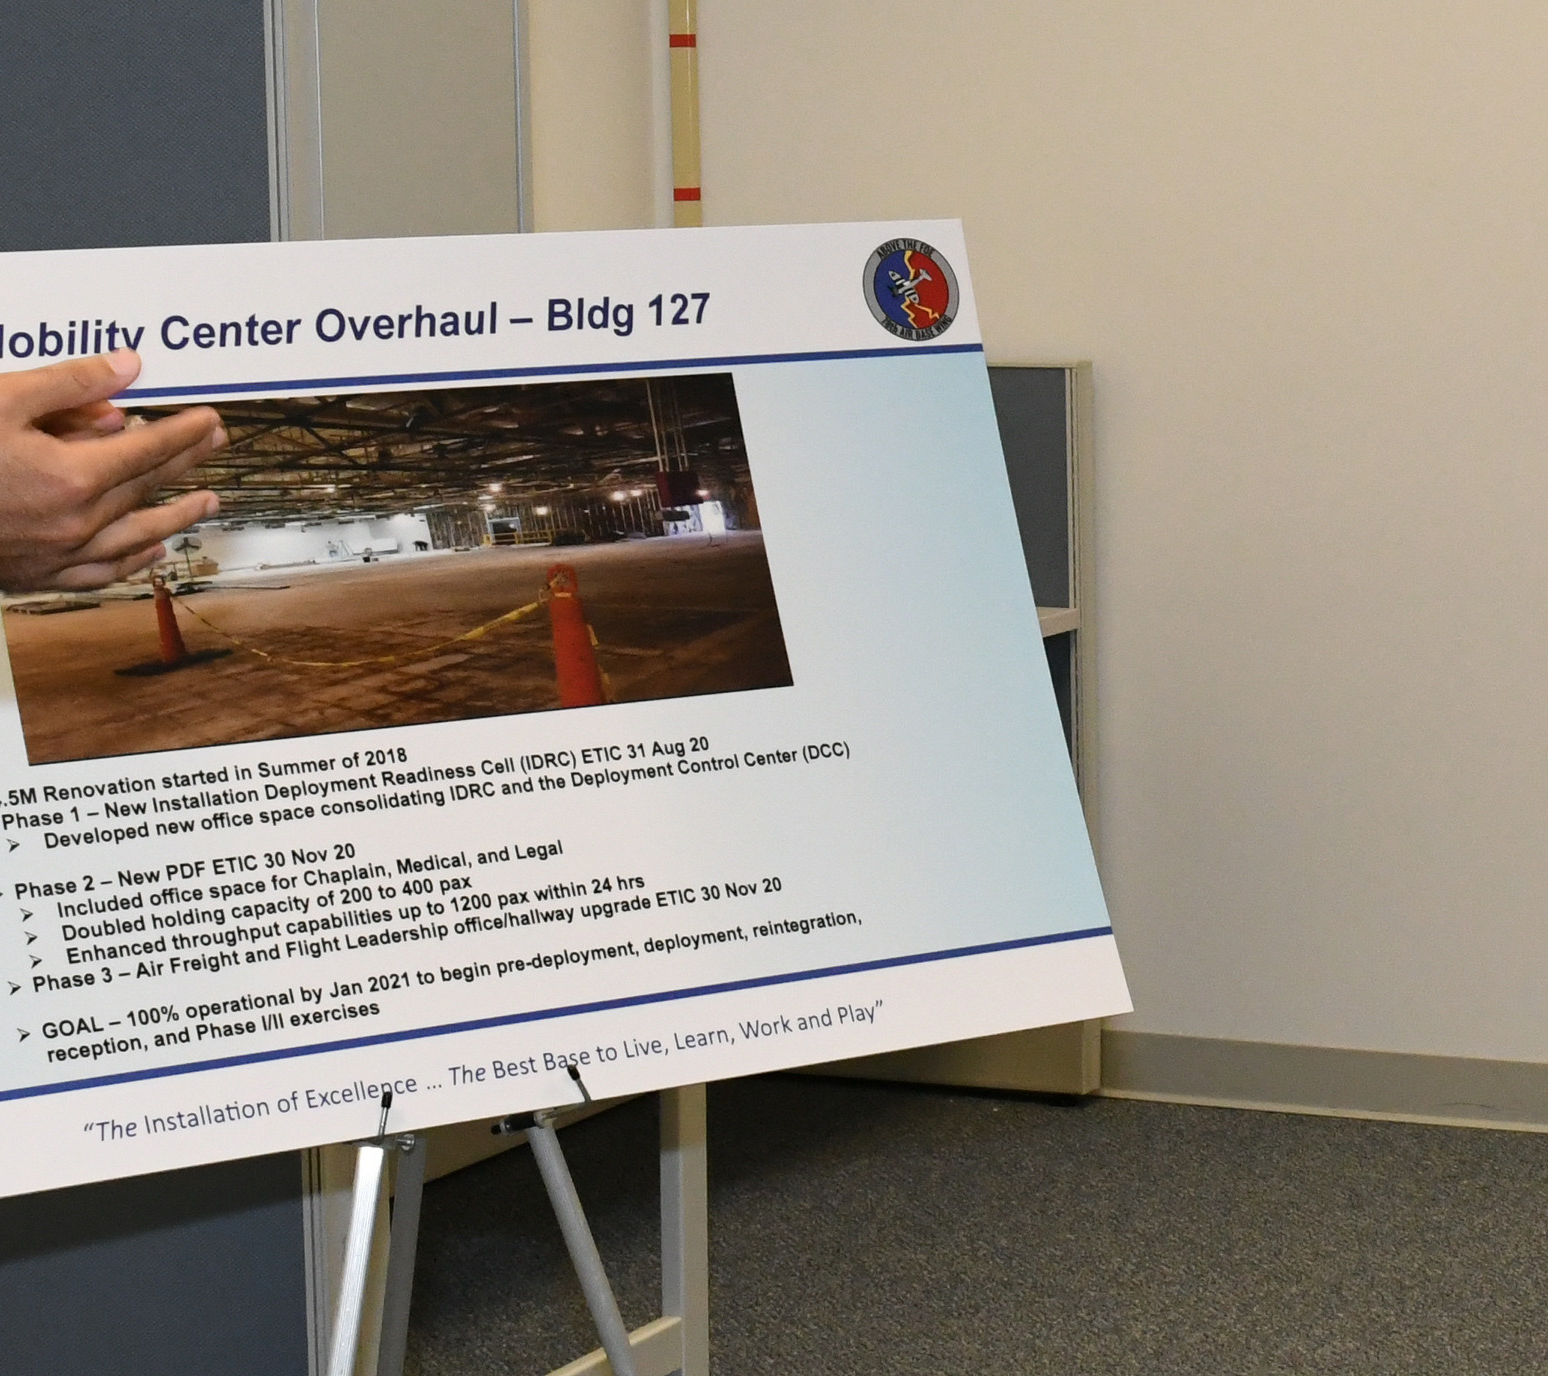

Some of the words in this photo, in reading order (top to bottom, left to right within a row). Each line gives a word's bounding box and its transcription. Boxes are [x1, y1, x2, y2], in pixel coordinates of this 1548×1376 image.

[876, 239, 902, 260] ABOVE
[902, 239, 918, 251] THE
[919, 241, 935, 258] FOE
[160, 313, 302, 351] Center
[315, 301, 498, 343] Overhaul
[547, 296, 634, 337] Bldg
[648, 292, 711, 327] 127
[900, 328, 914, 340] AIR
[915, 327, 935, 340] BASE
[935, 314, 953, 334] WING
[1, 811, 64, 831] Phase
[70, 806, 80, 823] 1
[104, 801, 147, 819] New
[151, 788, 260, 814] Installation
[264, 773, 378, 802] Deployment
[380, 765, 477, 787] Readiness
[480, 756, 516, 776] Cell
[520, 750, 577, 775] (IDRC)
[580, 745, 623, 765] ETIC
[626, 742, 646, 759] 31
[651, 741, 686, 758] Aug
[688, 736, 710, 753] 20
[42, 777, 156, 803] Renovation
[161, 766, 230, 789] started
[234, 764, 253, 781] in
[257, 758, 336, 779] Summer
[341, 751, 360, 769] of
[364, 747, 408, 767] 2018
[43, 821, 150, 850] Developed
[155, 819, 195, 836] new
[200, 811, 254, 831] office
[259, 805, 315, 827] space
[320, 789, 446, 817] consolidating
[449, 781, 496, 802] IDRC
[501, 776, 535, 796] and
[537, 775, 566, 791] the
[570, 762, 675, 789] Deployment
[677, 753, 740, 775] Control
[743, 749, 798, 768] Center
[802, 741, 850, 764] (DCC)
[14, 880, 77, 900] Phase
[82, 874, 96, 892] 2
[117, 869, 161, 887] New
[165, 860, 206, 881] PDF
[211, 854, 258, 876] ETIC
[263, 851, 286, 869] 30
[290, 848, 328, 866] Nov
[333, 842, 356, 861] 20
[56, 891, 144, 919] Included
[149, 887, 204, 907] office
[208, 880, 266, 902] space
[270, 874, 298, 891] for
[303, 862, 392, 887] Chaplain,
[395, 850, 473, 875] Medical,
[476, 845, 511, 865] and
[514, 839, 564, 861] Legal
[32, 972, 96, 993] Phase
[100, 966, 113, 984] 3
[136, 960, 164, 979] Air
[169, 950, 241, 974] Freight
[244, 943, 281, 964] and
[285, 936, 342, 959] Flight
[344, 922, 449, 950] Leadership
[453, 907, 575, 935] office/hallway
[580, 894, 652, 920] upgrade
[655, 887, 697, 908] ETIC
[700, 884, 721, 902] 30
[724, 882, 758, 899] Nov
[761, 876, 782, 894] 20
[61, 915, 146, 942] Doubled
[150, 907, 226, 930] holding
[231, 895, 310, 921] capacity
[316, 890, 335, 908] of
[339, 885, 373, 905] 200
[377, 885, 397, 900] to
[401, 878, 434, 896] 400
[439, 876, 473, 896] pax
[66, 935, 167, 965] Enhanced
[171, 921, 282, 951] throughput
[285, 908, 393, 936] capabilities
[398, 905, 422, 923] up
[426, 901, 445, 916] to
[450, 892, 492, 913] 1200
[497, 891, 531, 911] pax
[533, 881, 588, 902] within
[591, 876, 613, 895] 24
[616, 875, 646, 891] hrs
[41, 1016, 105, 1039] GOAL
[126, 1004, 180, 1027] 100%
[185, 987, 295, 1022] operational
[299, 986, 323, 1005] by
[329, 981, 363, 998] Jan
[367, 971, 410, 993] 2021
[415, 970, 435, 986] to
[439, 961, 492, 983] begin
[496, 941, 640, 978] pre-deployment,
[643, 925, 749, 954] deployment,
[752, 911, 862, 938] reintegration,
[47, 1036, 149, 1063] reception,
[153, 1026, 191, 1047] and
[195, 1020, 257, 1041] Phase
[261, 1012, 285, 1032] I/II
[289, 1002, 381, 1027] exercises
[83, 1119, 137, 1142] “The
[144, 1100, 270, 1134] Installation
[277, 1090, 299, 1113] of
[305, 1078, 418, 1109] Excellence
[448, 1064, 486, 1086] The
[492, 1056, 538, 1079] Best
[542, 1051, 591, 1072] Base
[595, 1046, 618, 1063] to
[623, 1038, 669, 1059] Live,
[673, 1029, 735, 1050] Learn,
[738, 1014, 793, 1040] Work
[797, 1007, 833, 1031] and
[837, 999, 883, 1024] Play”
